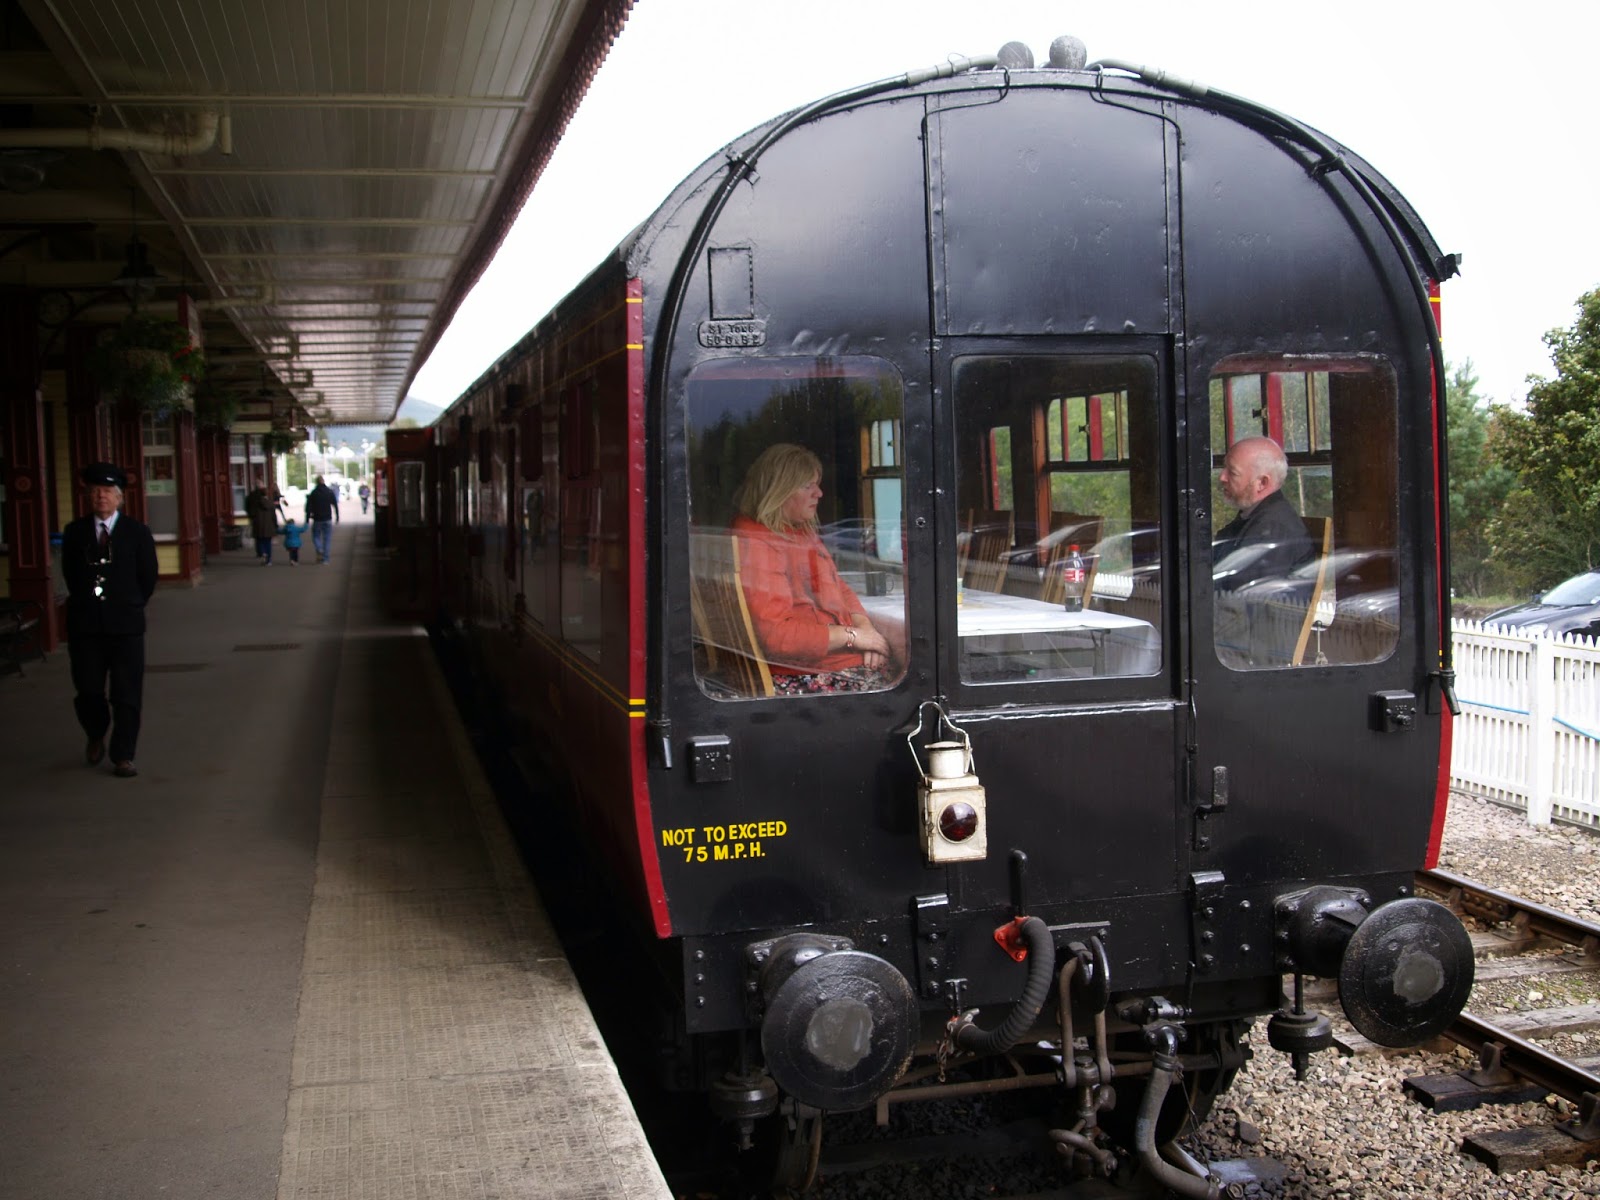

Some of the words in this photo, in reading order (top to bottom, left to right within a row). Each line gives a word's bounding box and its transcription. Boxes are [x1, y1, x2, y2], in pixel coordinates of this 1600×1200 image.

[661, 828, 695, 847] NOT
[703, 826, 726, 843] TO
[729, 820, 788, 840] EXCEED
[683, 846, 709, 863] 75
[714, 841, 767, 861] M.P.H.
